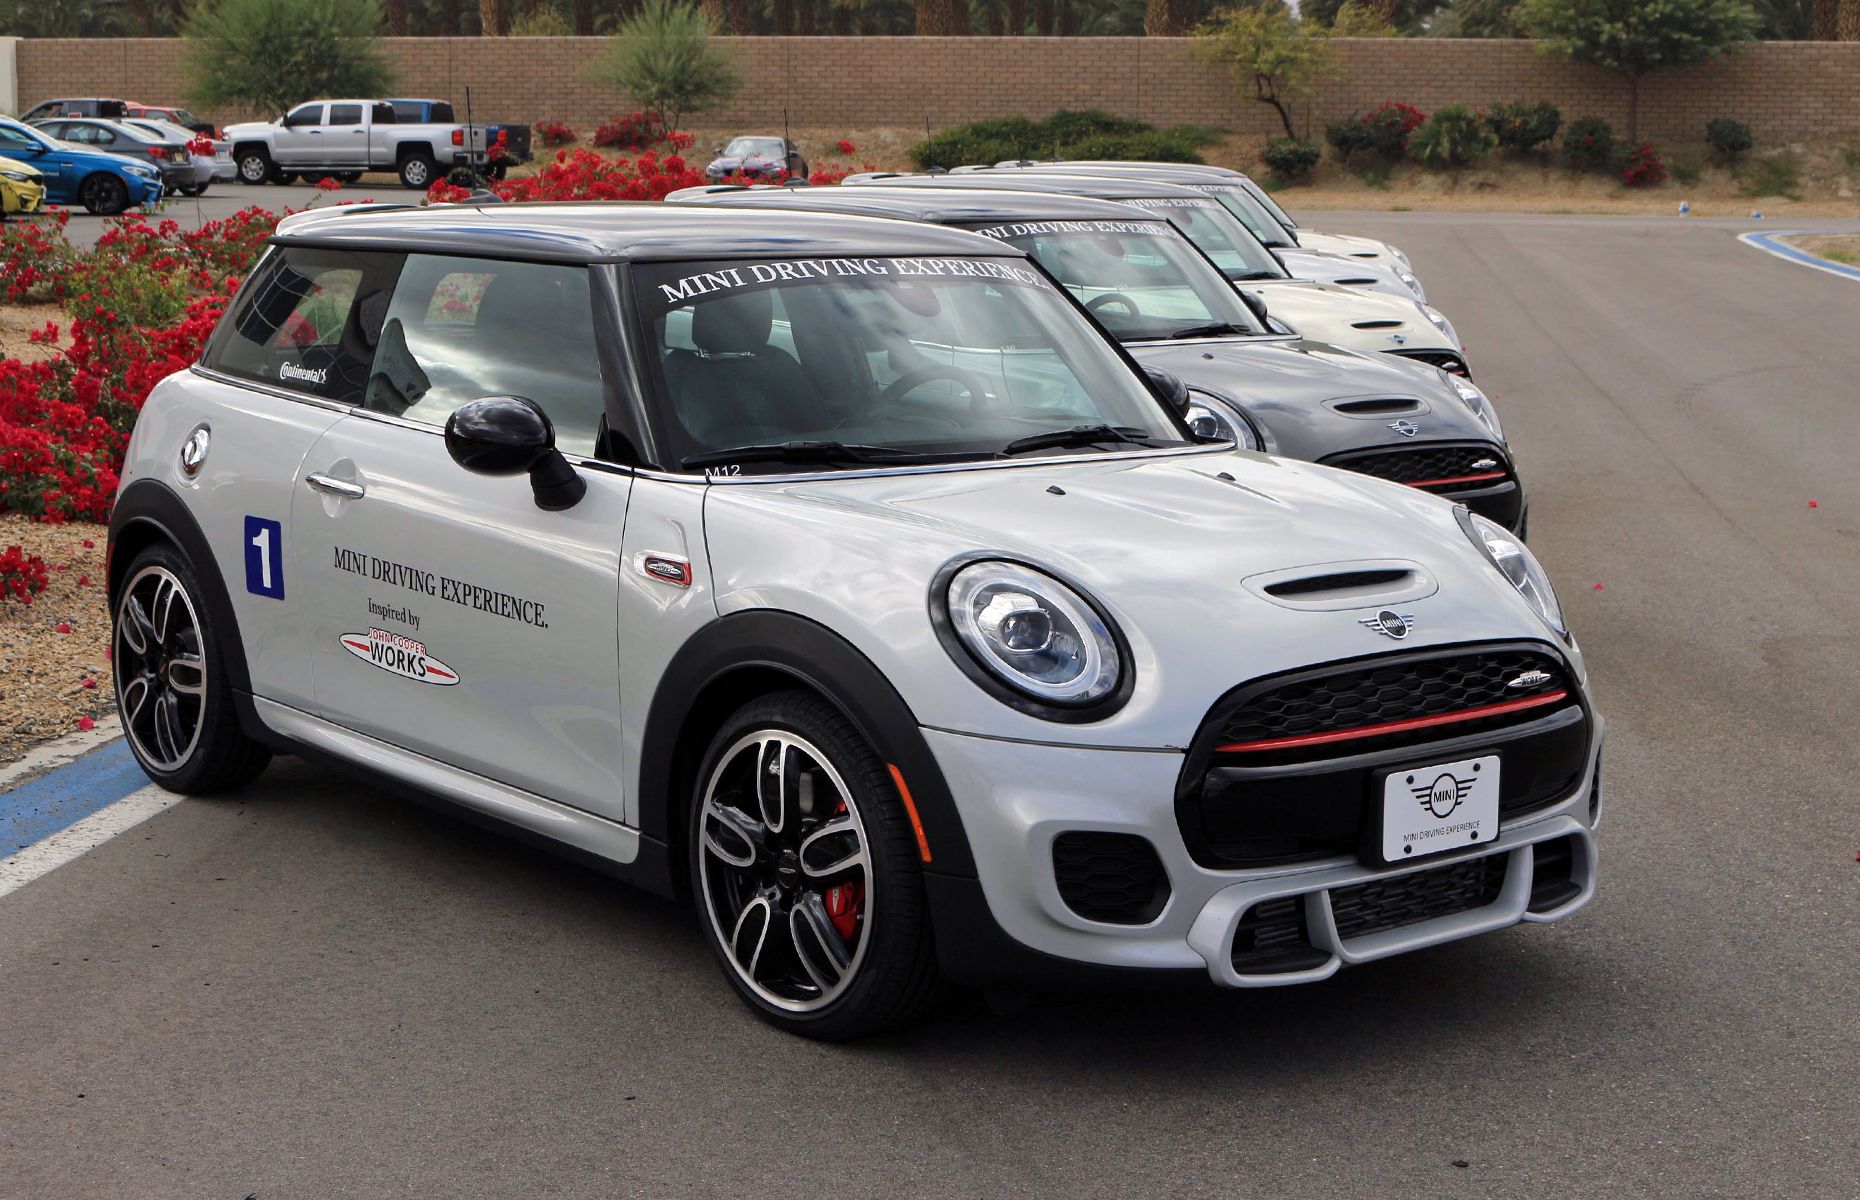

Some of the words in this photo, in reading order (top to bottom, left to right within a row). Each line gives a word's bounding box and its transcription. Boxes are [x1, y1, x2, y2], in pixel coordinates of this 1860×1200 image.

[975, 225, 1012, 240] NI
[1011, 221, 1094, 237] DRIVING
[657, 267, 748, 304] MINI
[747, 258, 889, 284] DRIVING
[280, 361, 322, 383] Continental
[704, 464, 742, 477] M12
[252, 527, 272, 589] 1
[334, 546, 368, 577] MINI
[371, 556, 437, 597] DRIVING
[440, 576, 549, 629] EXPERIENCE.
[367, 597, 407, 624] Inspired
[408, 609, 420, 631] by
[368, 627, 393, 643] JOHN
[392, 634, 426, 656] COOPER
[369, 640, 427, 678] WORKS
[1433, 788, 1456, 803] MINI
[1403, 833, 1419, 842] MINI
[1419, 827, 1445, 841] DRIVING
[1446, 820, 1481, 836] EXPERIENCE
